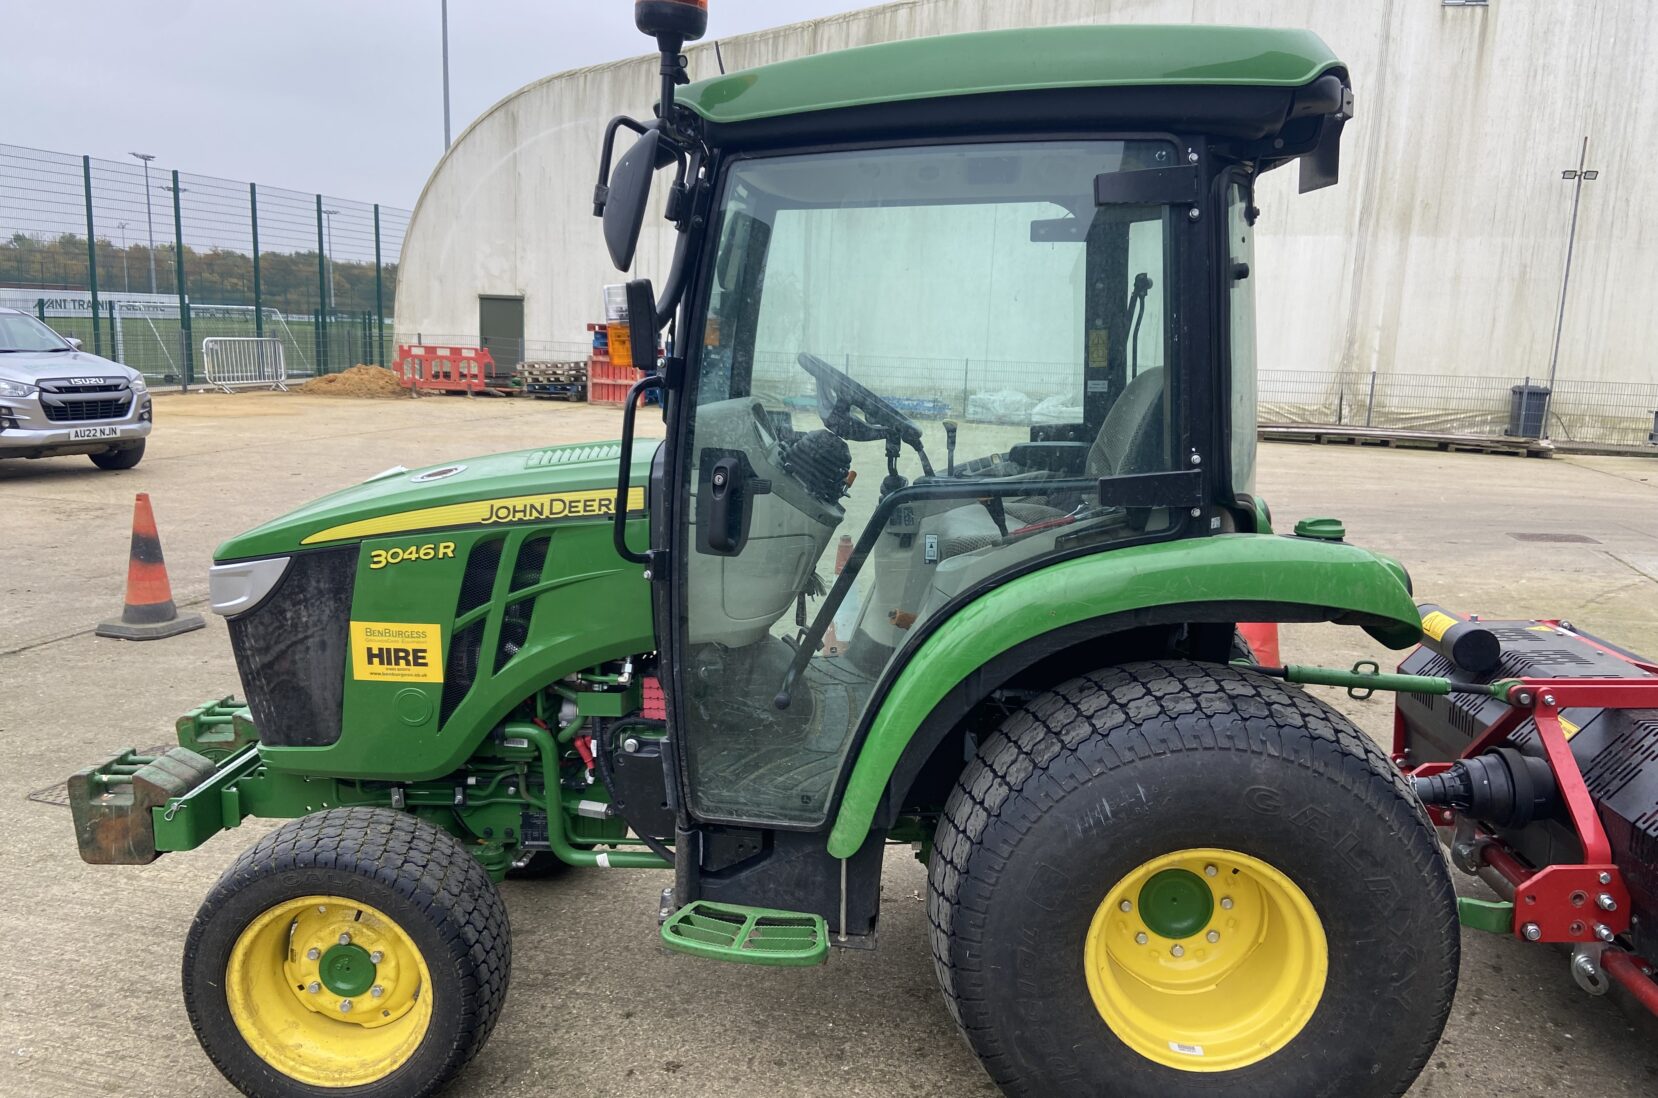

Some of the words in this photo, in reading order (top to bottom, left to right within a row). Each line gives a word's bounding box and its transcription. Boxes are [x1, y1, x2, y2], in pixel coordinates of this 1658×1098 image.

[74, 429, 98, 439] AU22
[100, 427, 118, 437] NJN
[481, 502, 545, 523] JOHN
[550, 497, 618, 517] DEER
[366, 647, 428, 667] HIRE
